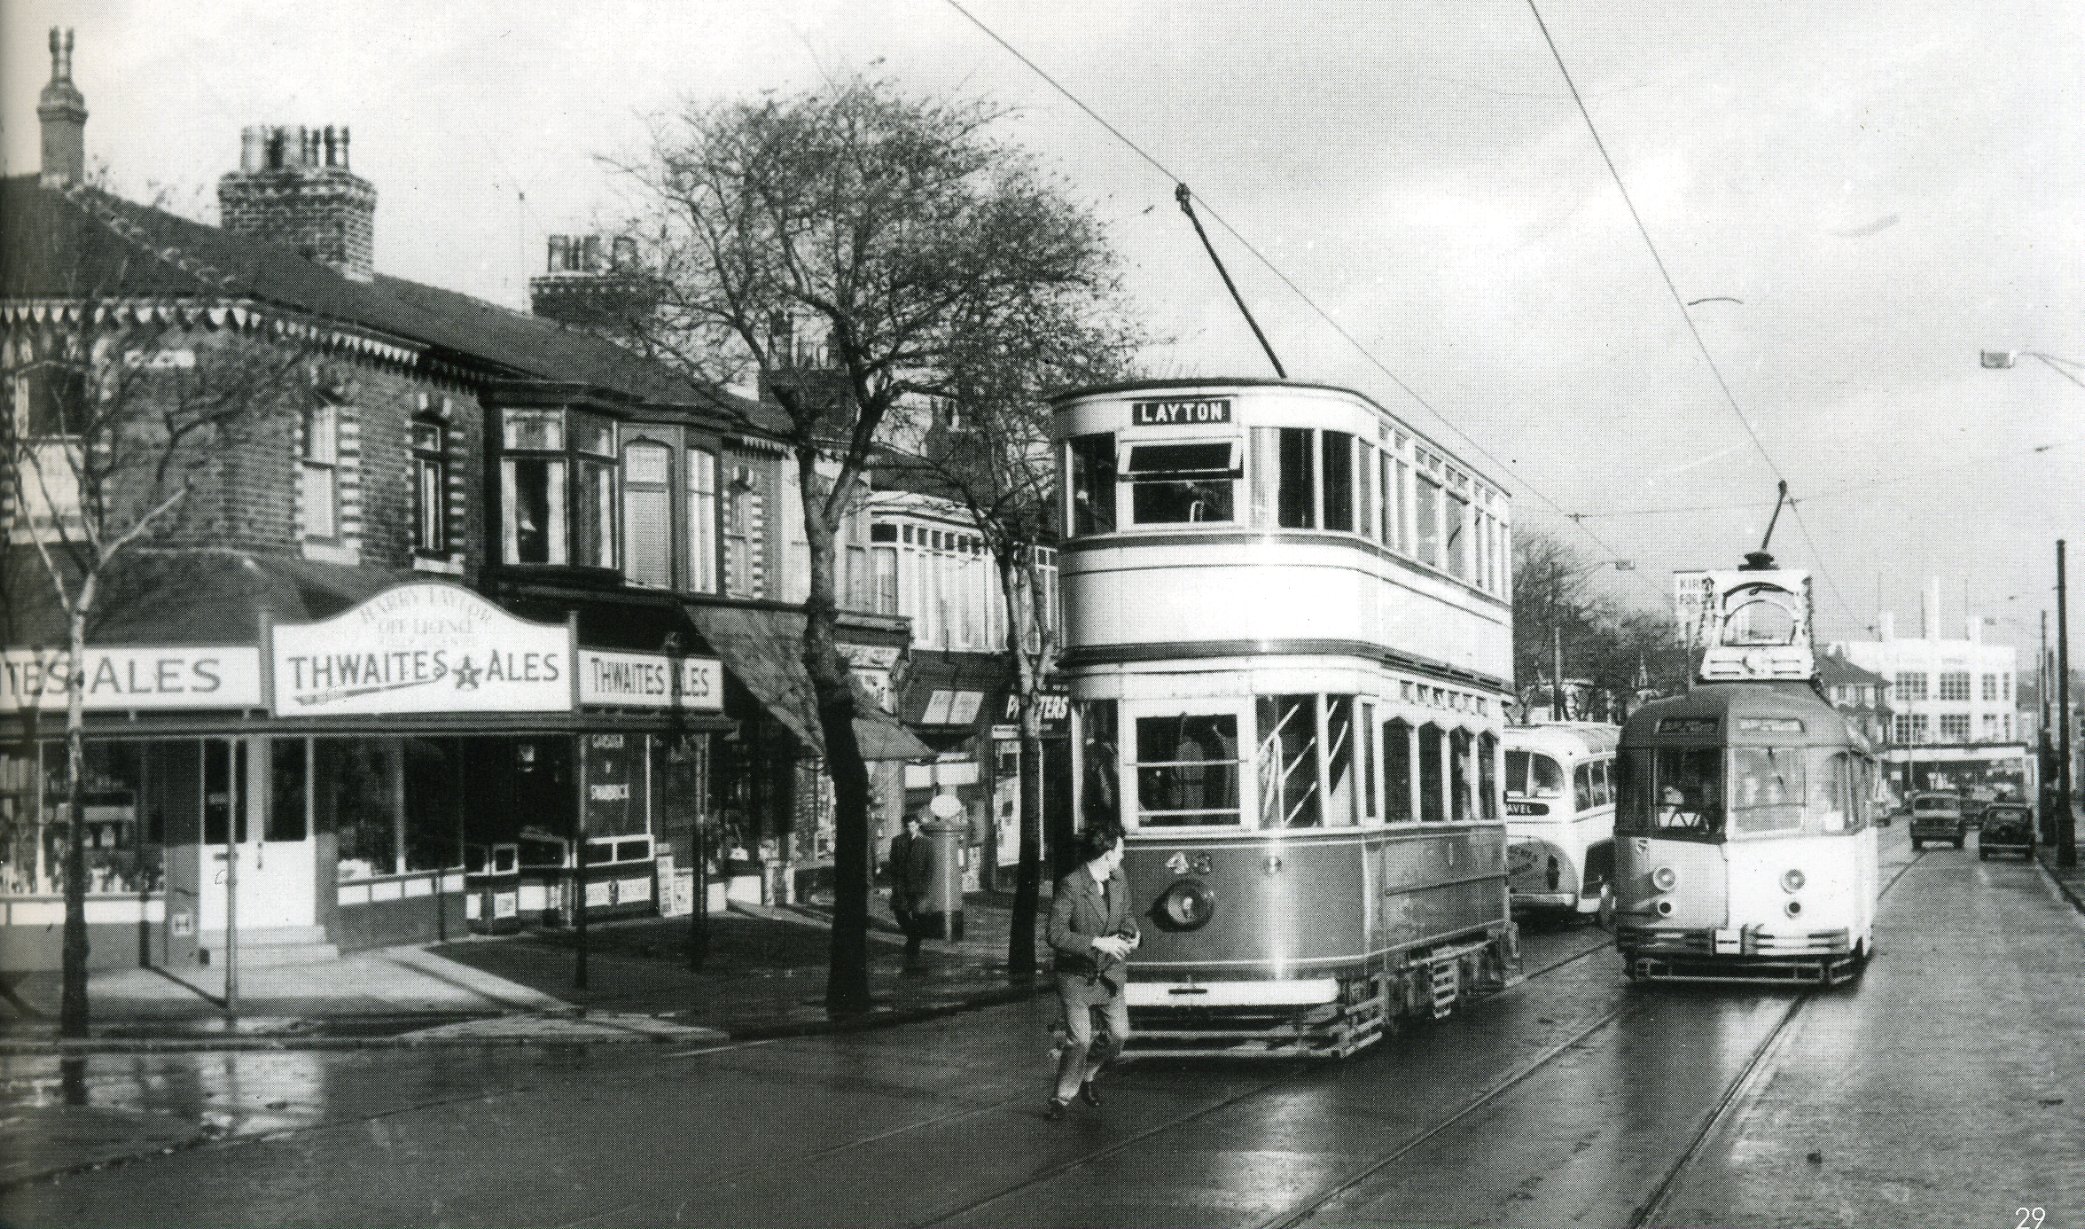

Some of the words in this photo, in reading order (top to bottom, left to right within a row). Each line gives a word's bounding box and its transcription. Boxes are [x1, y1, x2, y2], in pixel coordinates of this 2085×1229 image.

[1141, 402, 1223, 422] LAYTON
[89, 656, 222, 694] ALES
[287, 649, 448, 692] THWAITES
[486, 648, 560, 683] ALES
[591, 658, 664, 695] THWAITES
